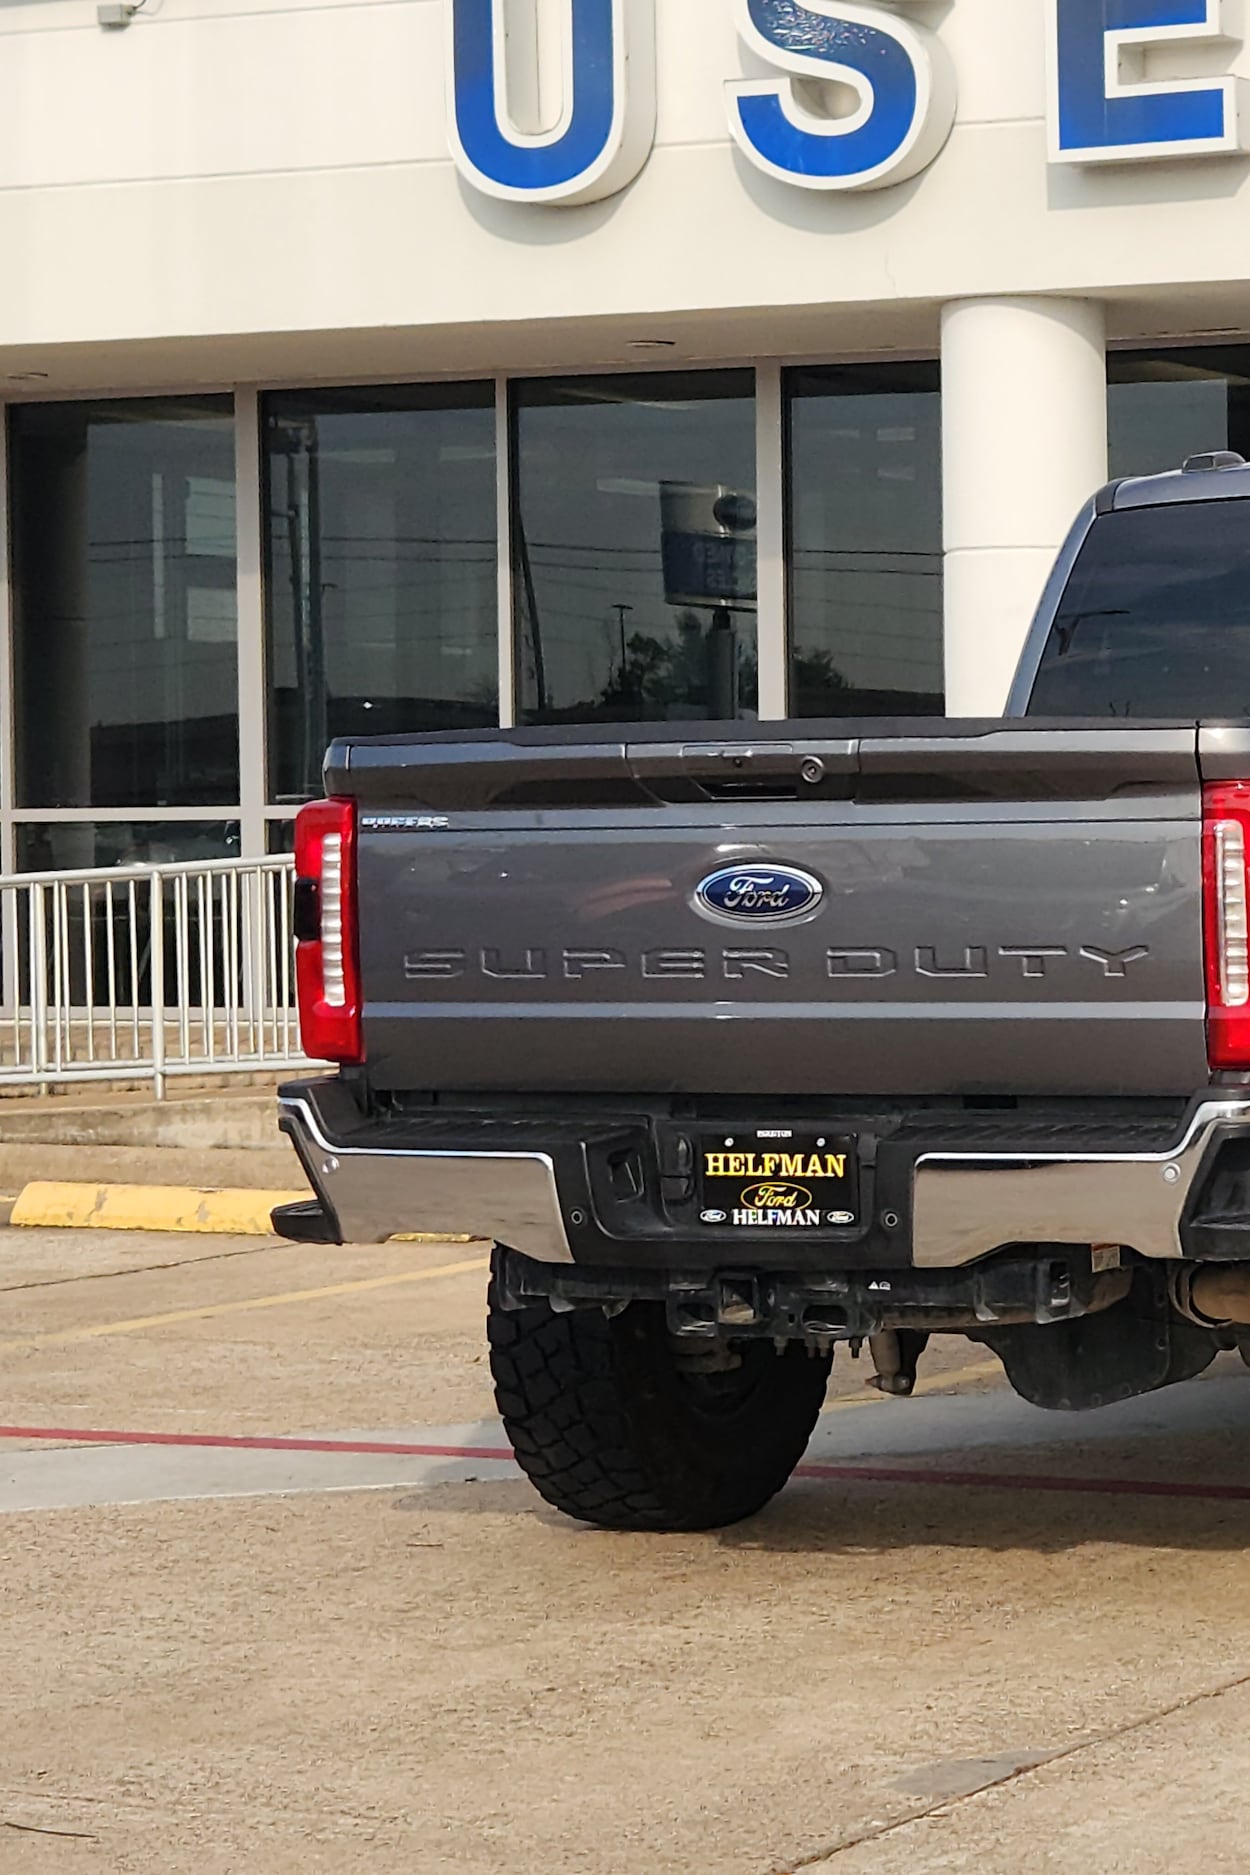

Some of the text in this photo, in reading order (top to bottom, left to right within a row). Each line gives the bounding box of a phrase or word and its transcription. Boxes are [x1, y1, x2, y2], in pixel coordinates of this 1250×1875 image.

[724, 876, 791, 908] Ford
[403, 944, 1149, 980] SUPER DUTY
[704, 1152, 847, 1178] HELFMAN
[754, 1185, 798, 1208] Ford
[732, 1209, 820, 1226] HELFMAN
